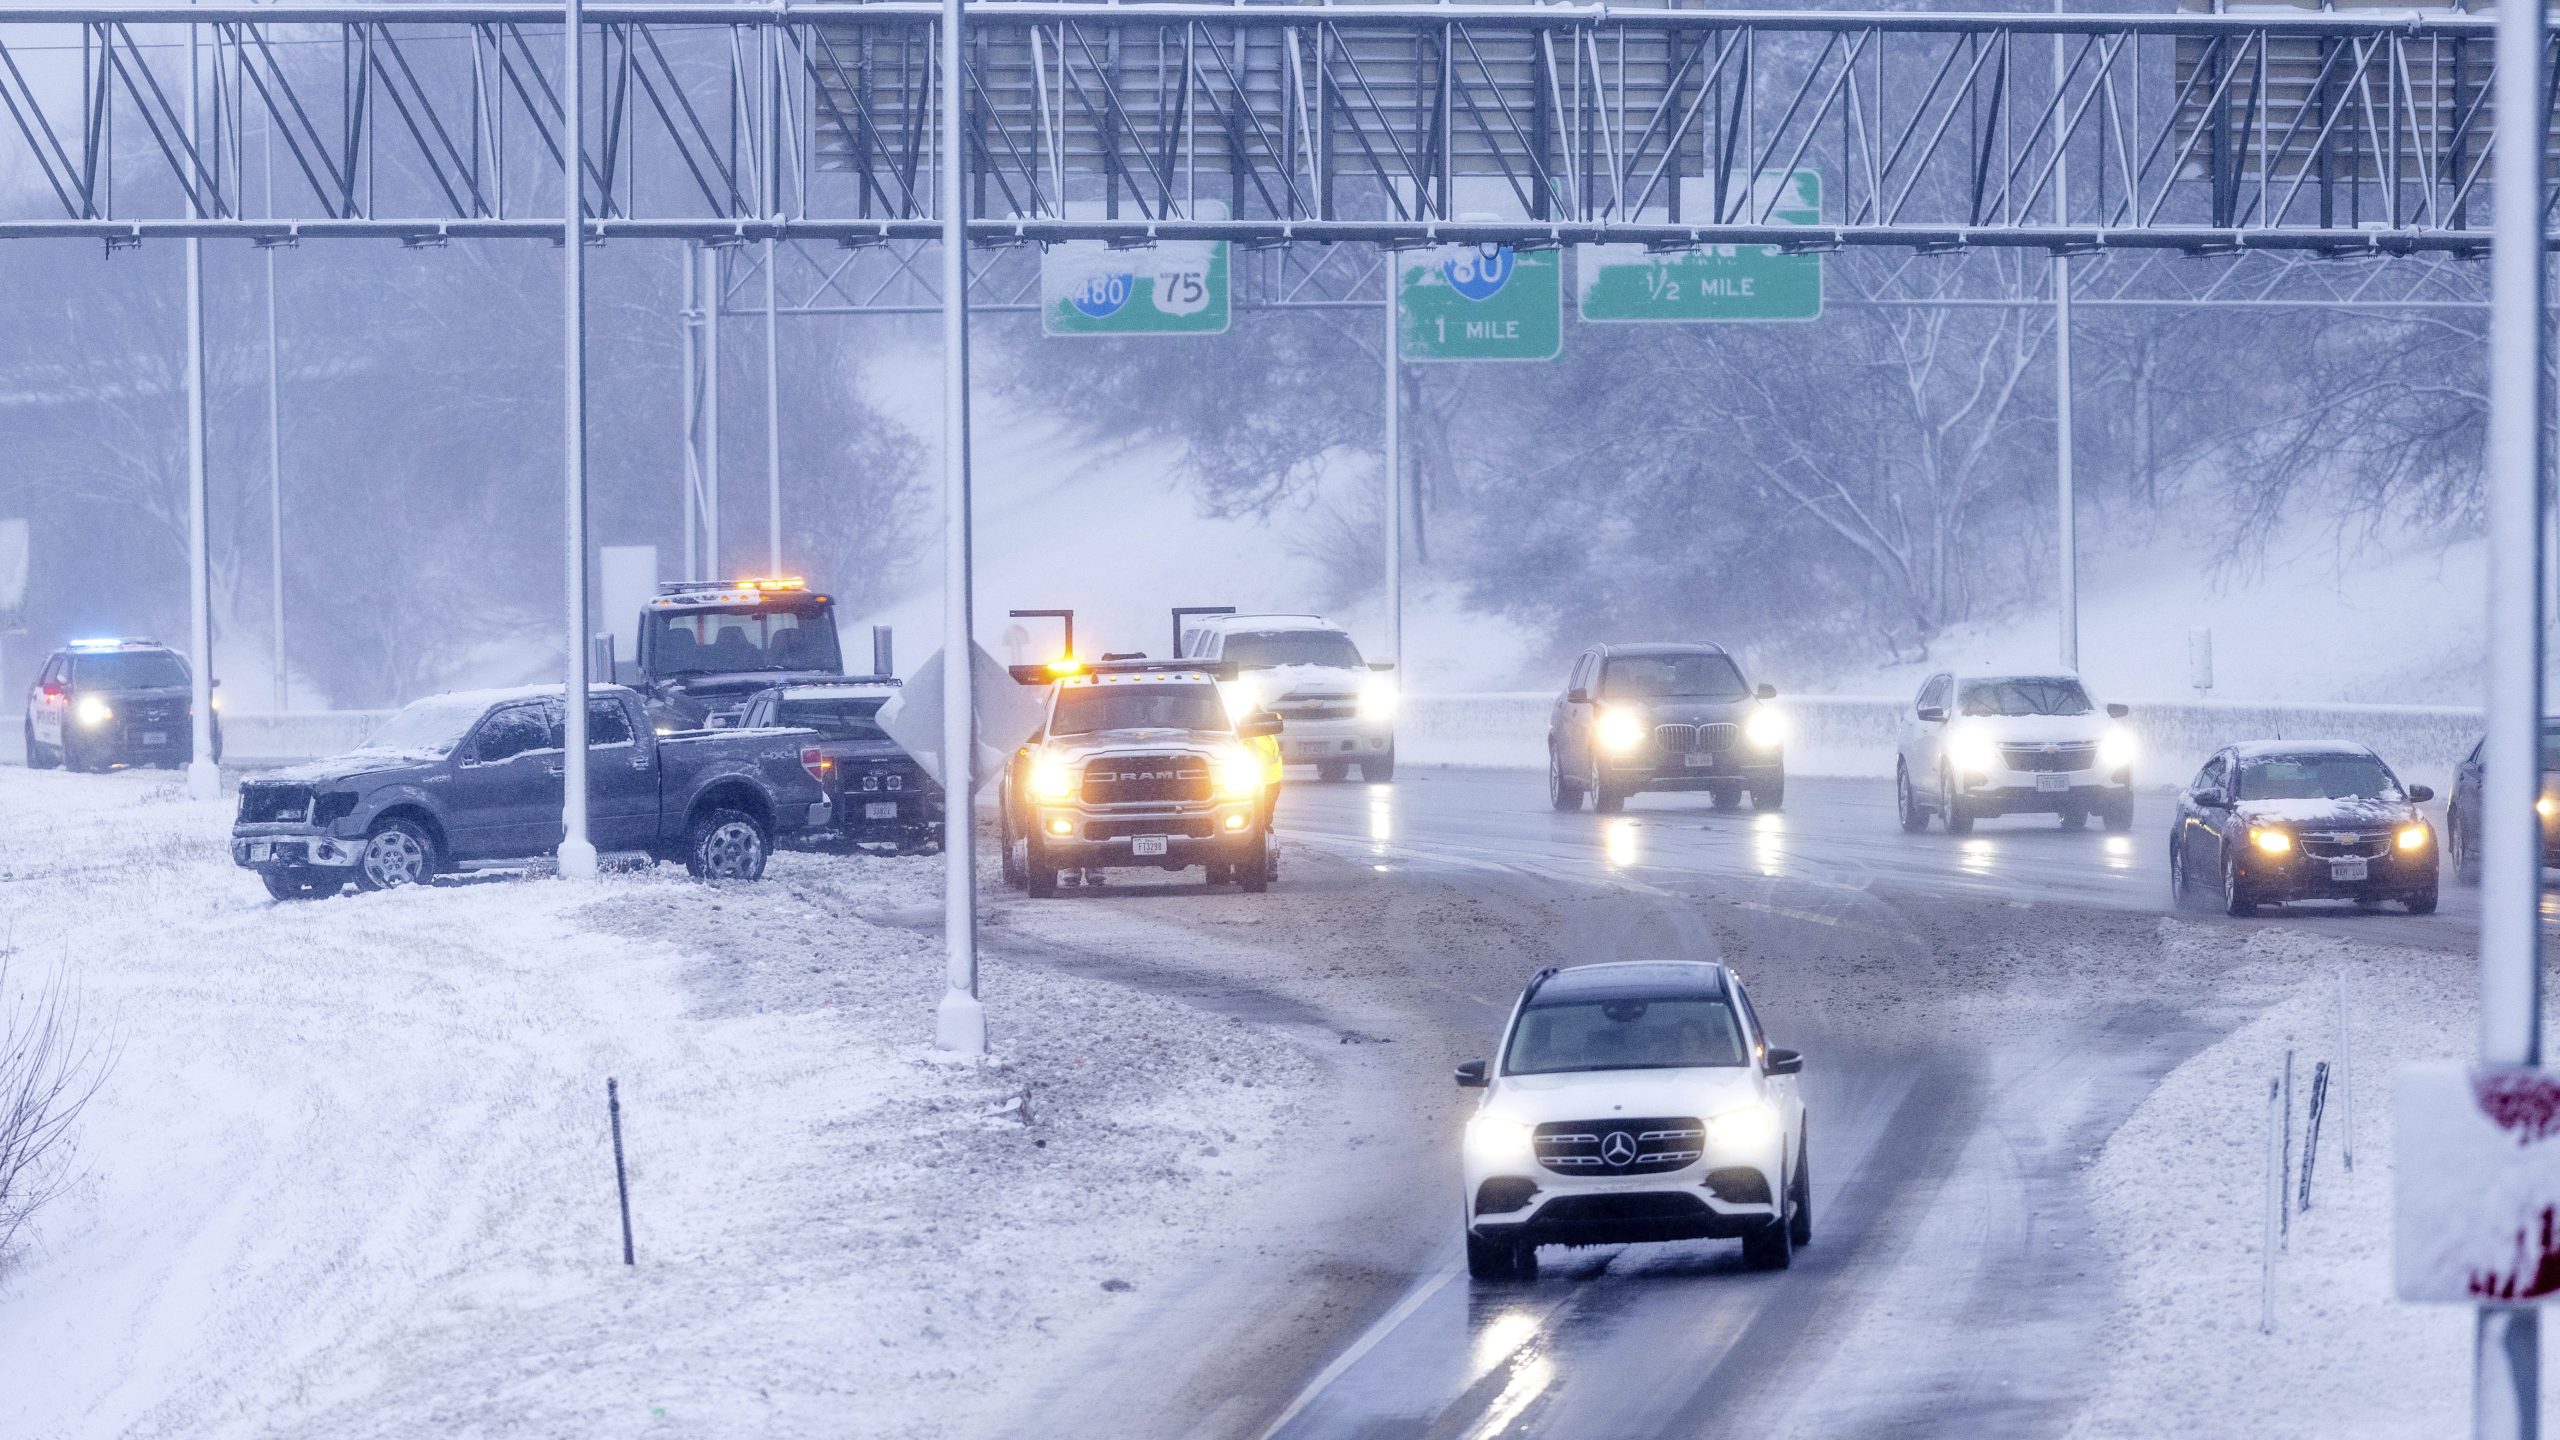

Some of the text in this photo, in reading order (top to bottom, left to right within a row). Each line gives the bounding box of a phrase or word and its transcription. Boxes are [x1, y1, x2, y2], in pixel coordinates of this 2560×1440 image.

[1453, 245, 1502, 283] 80
[1073, 273, 1124, 304] 480
[1159, 272, 1203, 302] 75
[1701, 278, 1755, 296] MILE
[1435, 317, 1519, 343] 1 MILE
[1120, 771, 1173, 781] RAM
